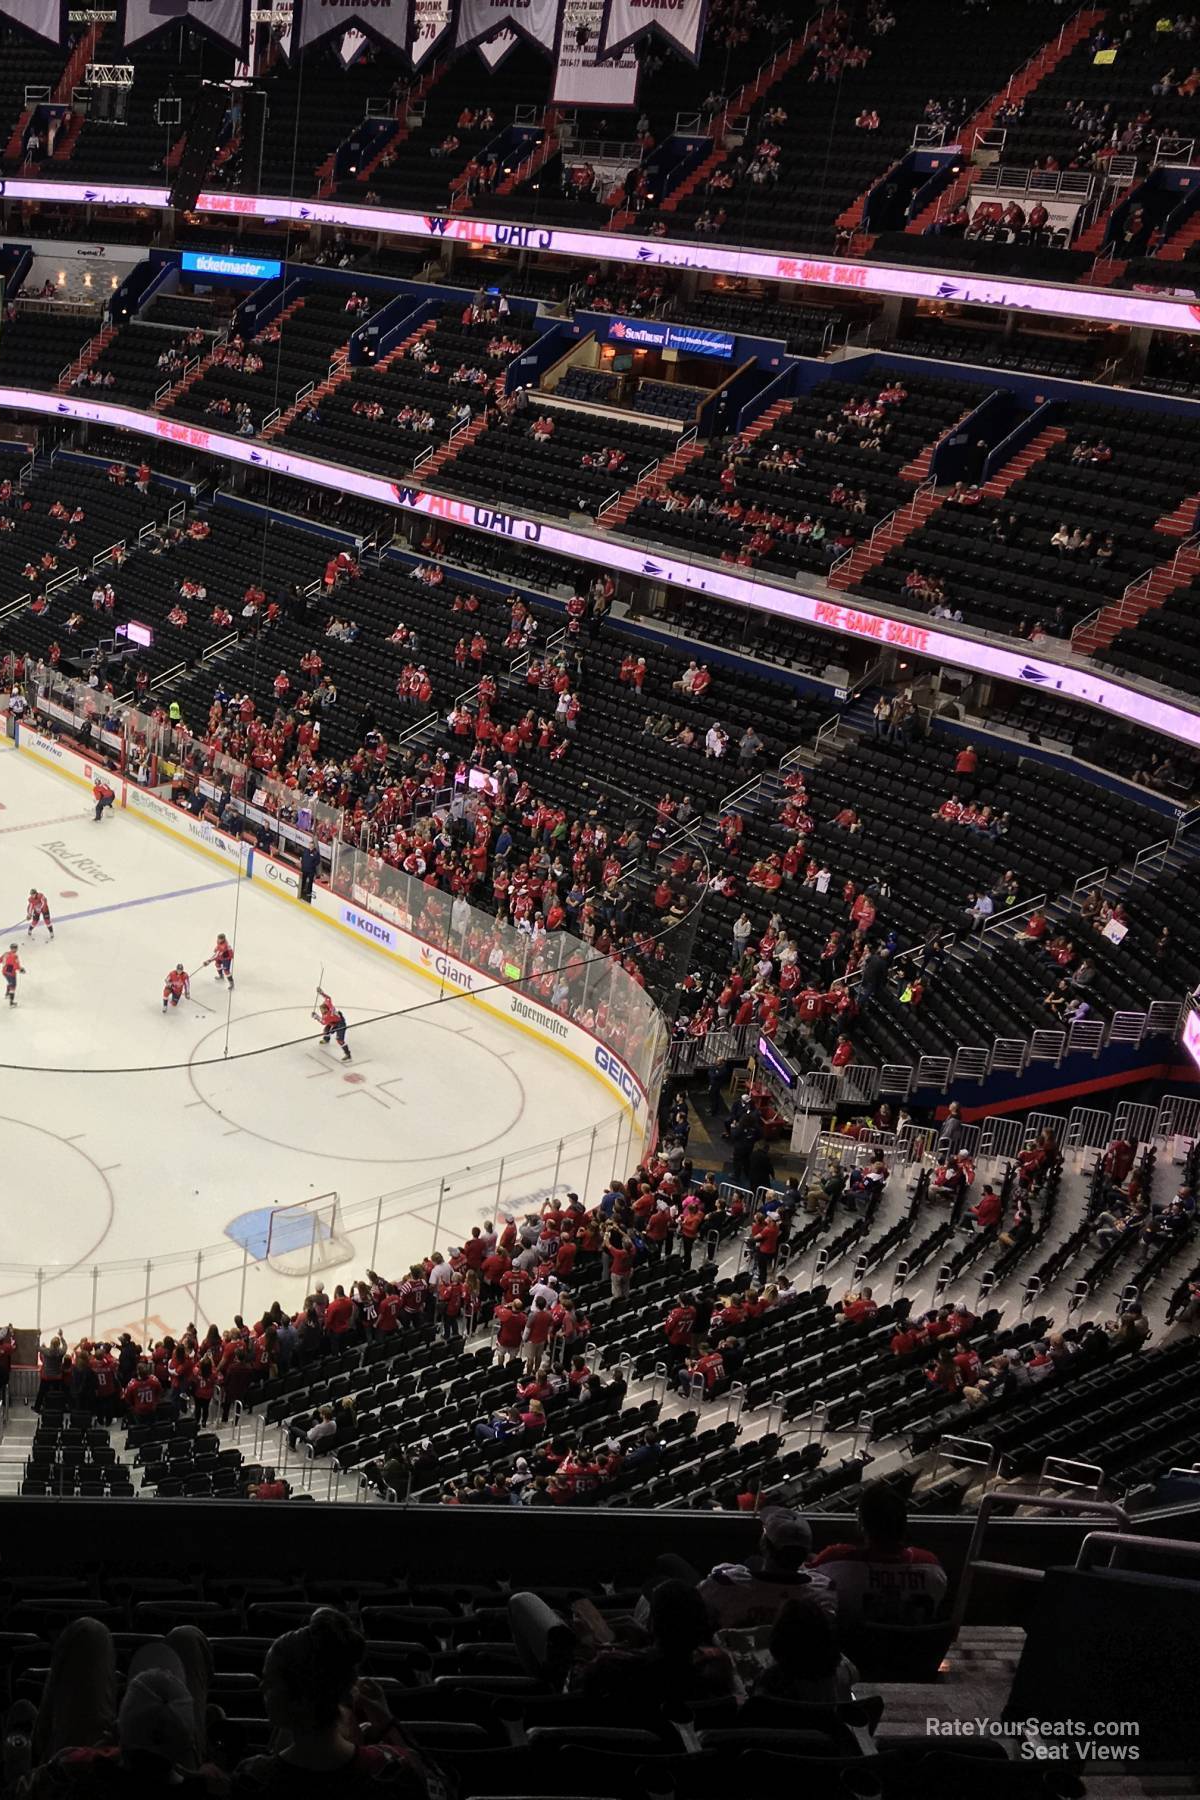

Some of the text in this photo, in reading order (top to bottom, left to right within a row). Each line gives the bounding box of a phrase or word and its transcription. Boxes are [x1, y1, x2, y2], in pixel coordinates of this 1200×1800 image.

[615, 60, 636, 68] WIZARDS
[776, 260, 869, 287] PRE-GAME SKATE
[814, 601, 930, 650] PRE-GAME SKATE
[35, 739, 63, 758] BOEING
[41, 841, 115, 882] Red River
[436, 957, 473, 990] Giant
[806, 998, 815, 1011] 8
[511, 996, 569, 1038] Jägermeister
[595, 1046, 641, 1108] GEICO
[512, 1283, 520, 1295] 8
[678, 1320, 693, 1333] 77
[138, 1390, 153, 1404] 70
